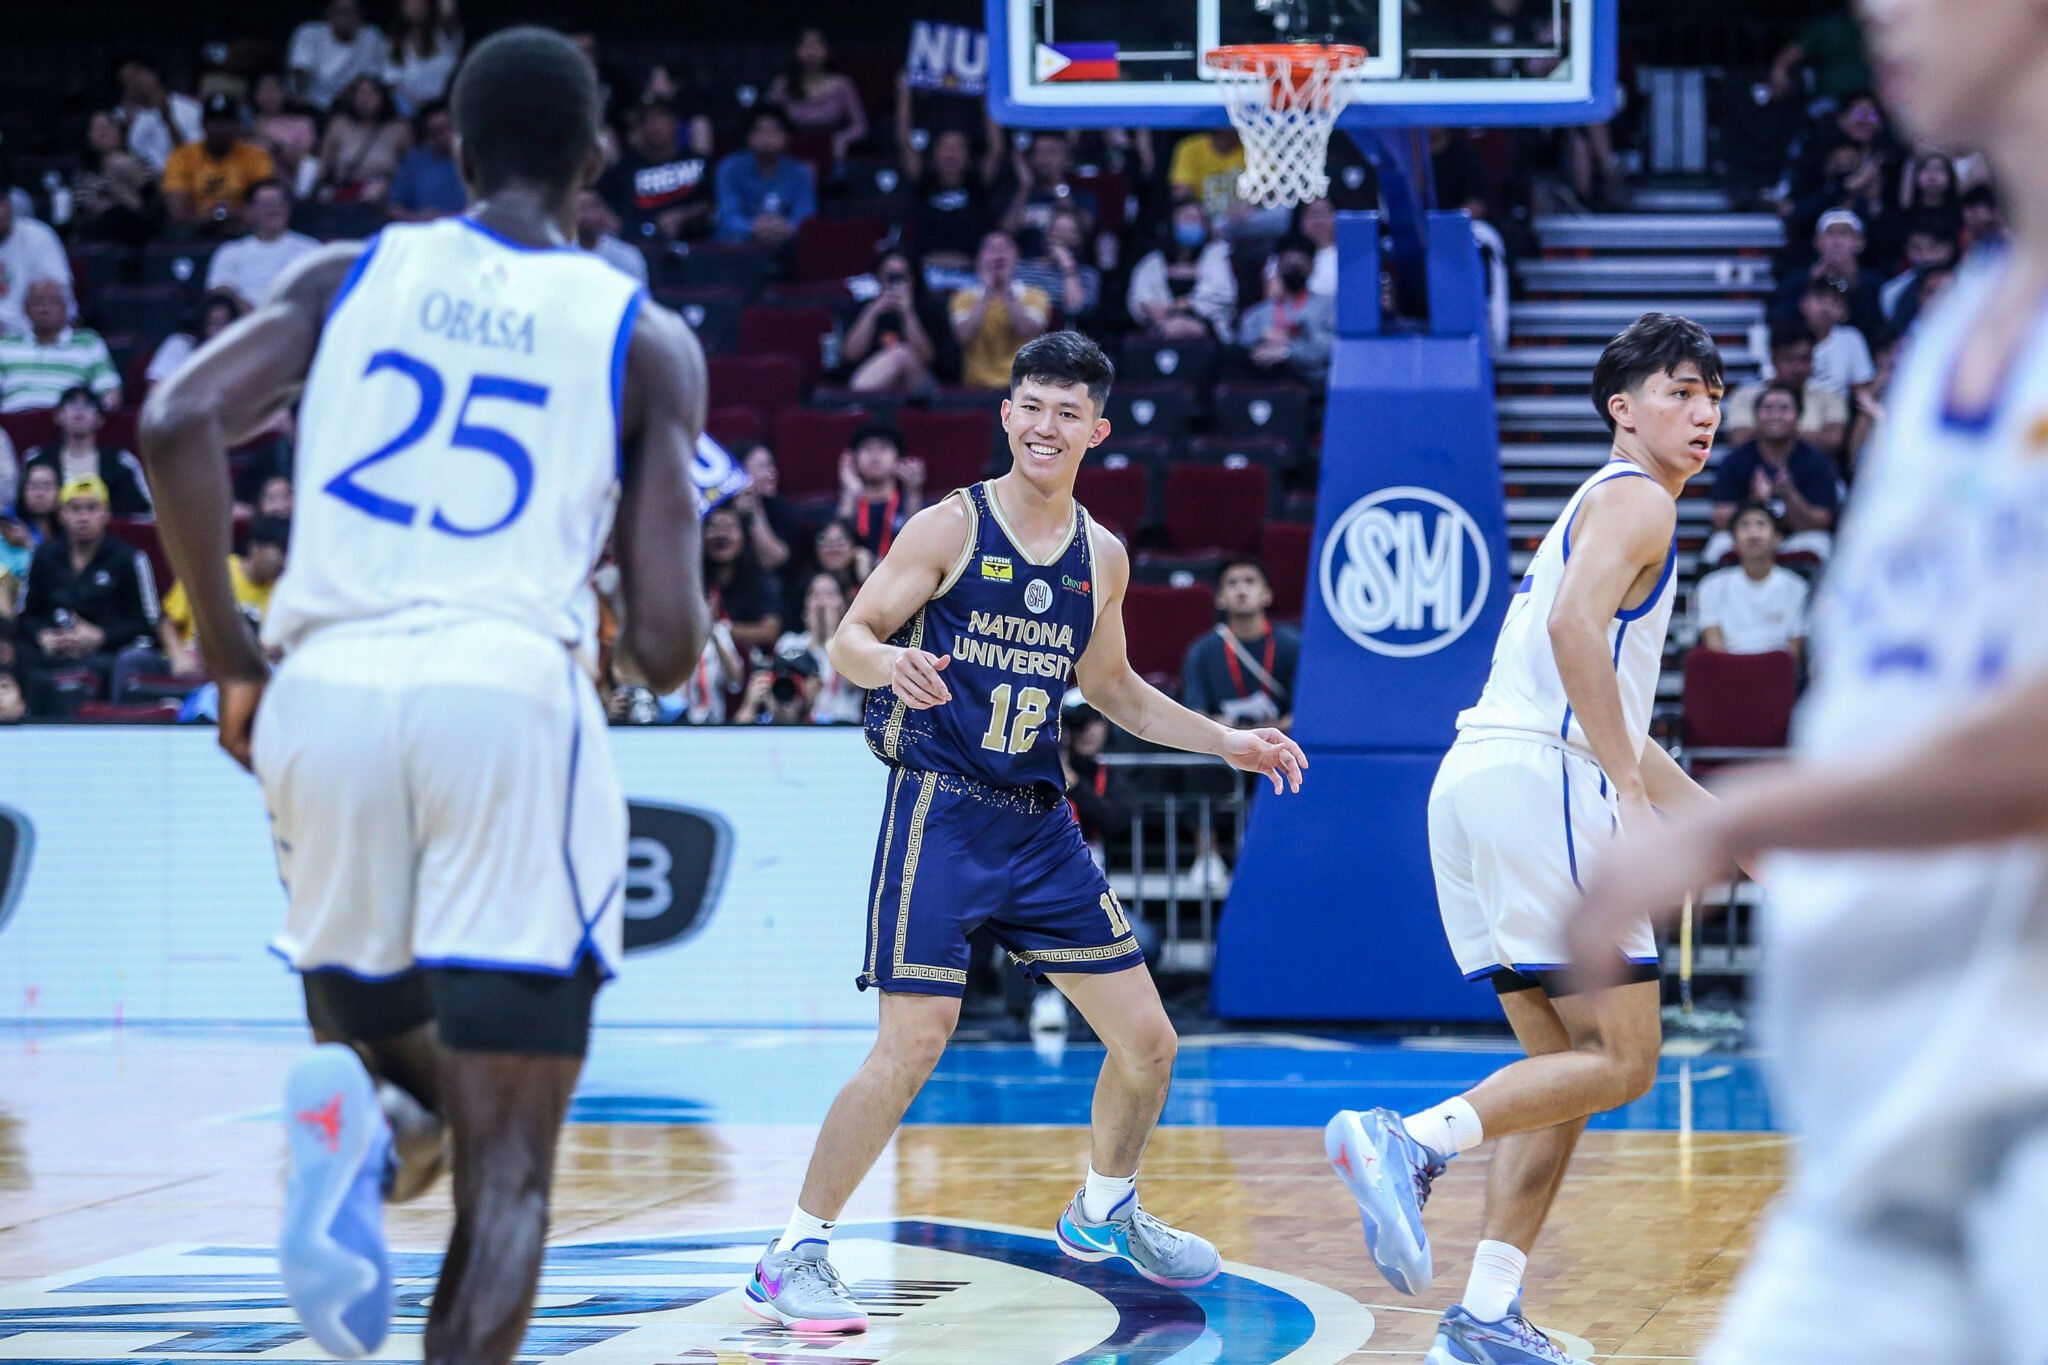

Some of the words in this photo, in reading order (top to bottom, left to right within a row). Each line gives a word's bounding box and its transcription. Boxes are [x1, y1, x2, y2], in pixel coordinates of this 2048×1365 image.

[908, 21, 988, 75] NU
[420, 290, 536, 354] OBASA
[322, 348, 552, 539] 25
[982, 555, 1011, 564] BOYSEN
[1335, 506, 1464, 633] SM
[952, 634, 1074, 683] UNIVERSIT
[980, 683, 1050, 755] 12
